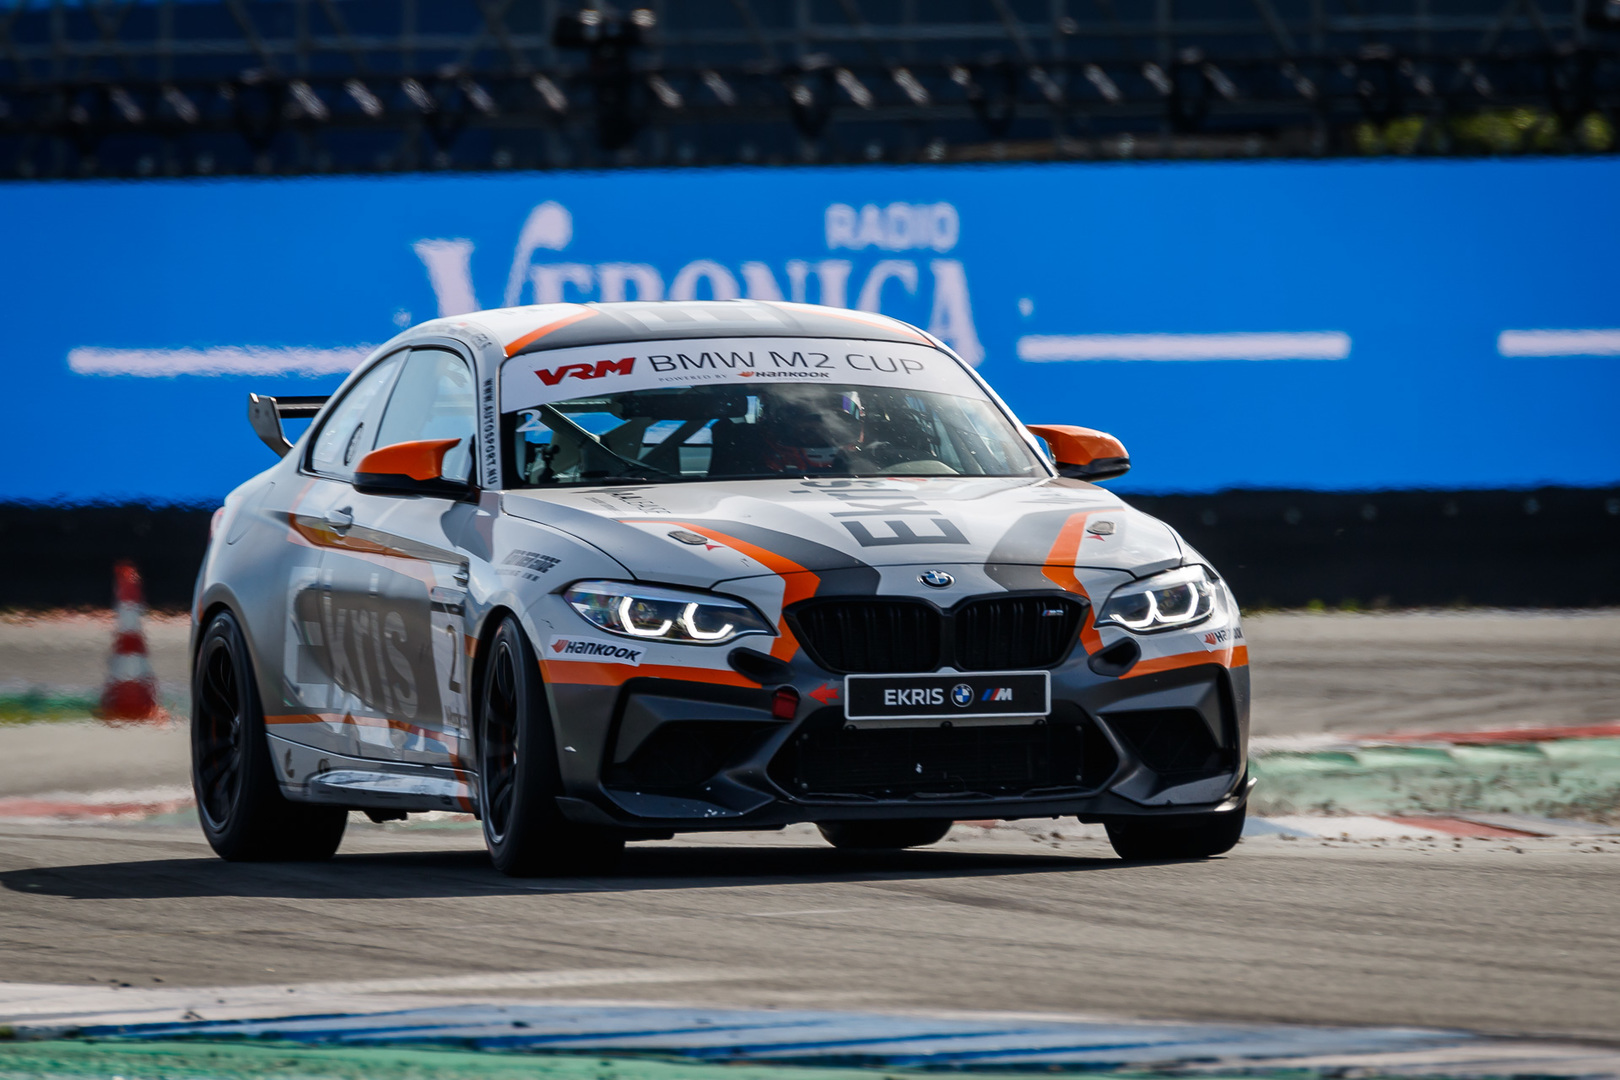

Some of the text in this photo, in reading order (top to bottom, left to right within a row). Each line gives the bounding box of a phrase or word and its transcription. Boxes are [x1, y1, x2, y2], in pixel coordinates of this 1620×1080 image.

[825, 203, 960, 252] RADIO
[534, 357, 636, 386] VRM
[648, 351, 925, 375] BMW M2 CUP
[658, 373, 711, 383] POWERED
[516, 409, 553, 433] 2
[884, 688, 945, 706] EKRIS
